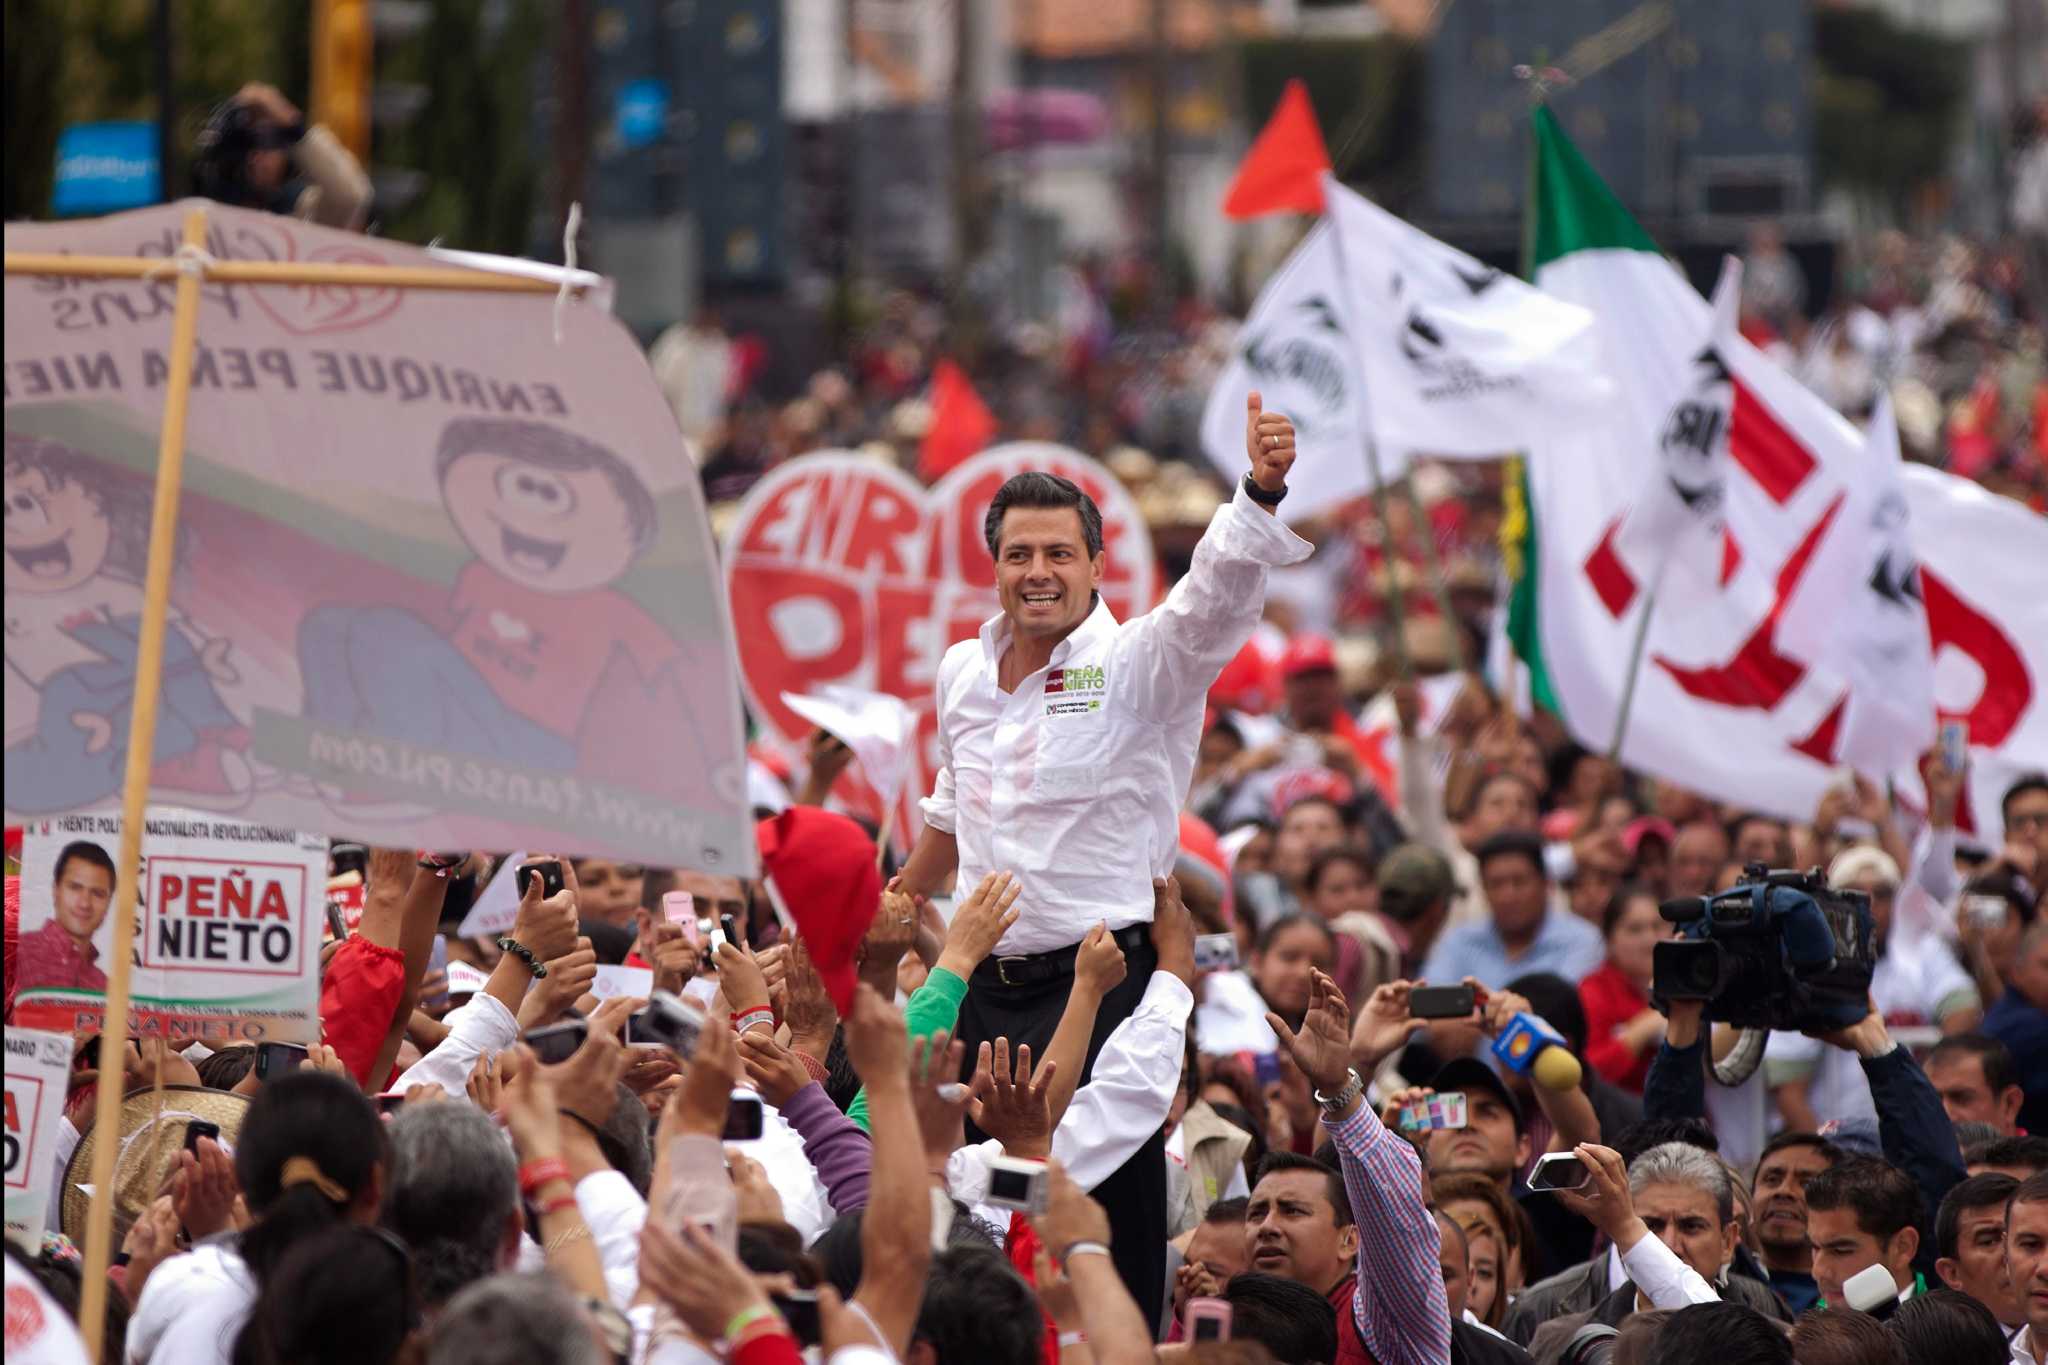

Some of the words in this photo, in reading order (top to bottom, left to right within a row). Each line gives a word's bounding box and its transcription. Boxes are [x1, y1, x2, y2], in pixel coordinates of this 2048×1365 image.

[1064, 665, 1105, 679] PEÑA
[1064, 679, 1105, 691] NIETO
[57, 816, 95, 834] FRENTE
[145, 821, 210, 839] NACIONALISTA
[212, 823, 297, 844] REVOLUCIONARIO
[157, 869, 290, 921] PEÑA
[157, 919, 292, 964] NIETO
[75, 1012, 162, 1034] PA
[168, 1017, 266, 1039] NIETO
